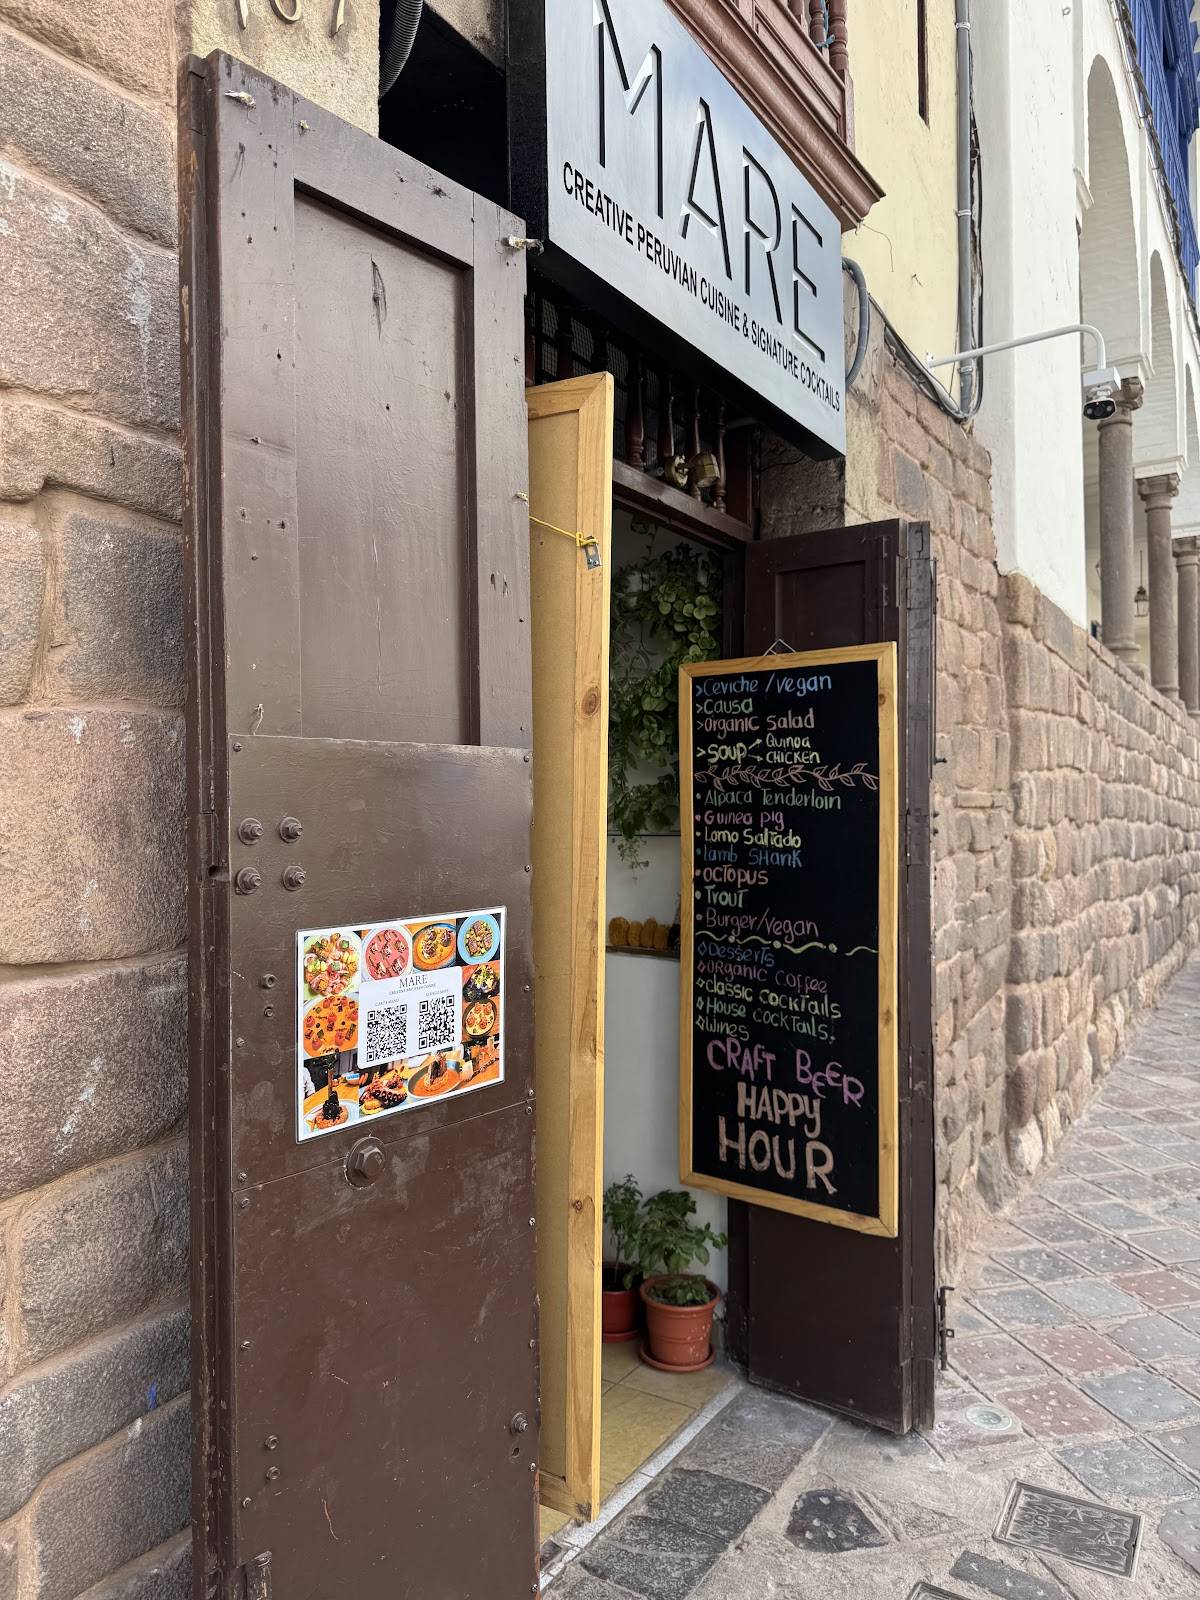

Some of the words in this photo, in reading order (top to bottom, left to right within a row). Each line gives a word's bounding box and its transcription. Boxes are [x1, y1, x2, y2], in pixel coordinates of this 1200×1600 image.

[592, 0, 825, 363] MARE
[563, 161, 634, 246] CREATIVE
[637, 222, 698, 297] PERUVIAN
[700, 277, 740, 332] CUISINE
[742, 312, 749, 338] &
[751, 320, 799, 379] SIGNATURE
[800, 361, 841, 412] COCKTAILS
[704, 810, 753, 825] Guinea
[760, 787, 841, 810] Tenderloin
[399, 974, 428, 989] MARE
[706, 1036, 777, 1082] CRAFT
[718, 1115, 838, 1195] HOUR
